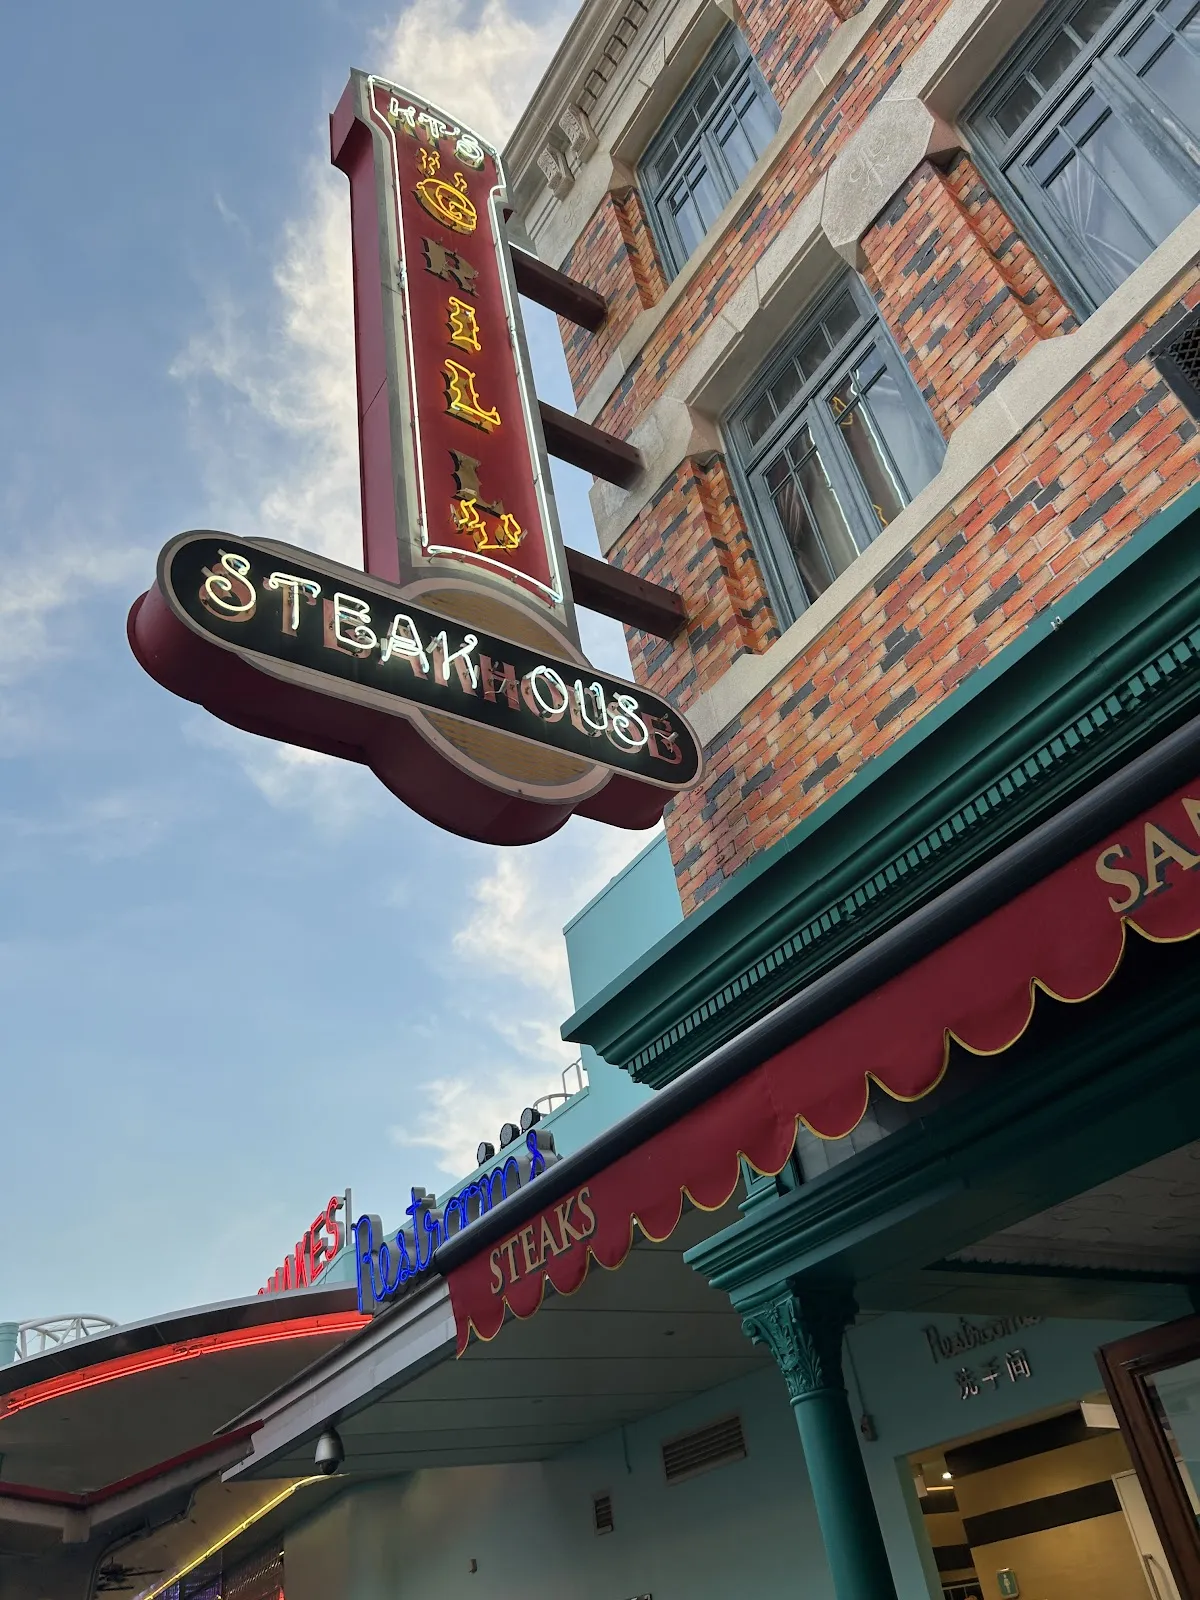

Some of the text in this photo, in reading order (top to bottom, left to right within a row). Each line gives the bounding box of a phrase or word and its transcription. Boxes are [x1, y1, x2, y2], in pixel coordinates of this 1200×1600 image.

[387, 97, 485, 171] KT'S
[412, 177, 524, 555] GRILL
[199, 549, 683, 766] STEAKHOUSE
[1096, 797, 1200, 913] SA
[352, 1129, 550, 1314] Restrooms
[488, 1186, 597, 1295] STEAKS
